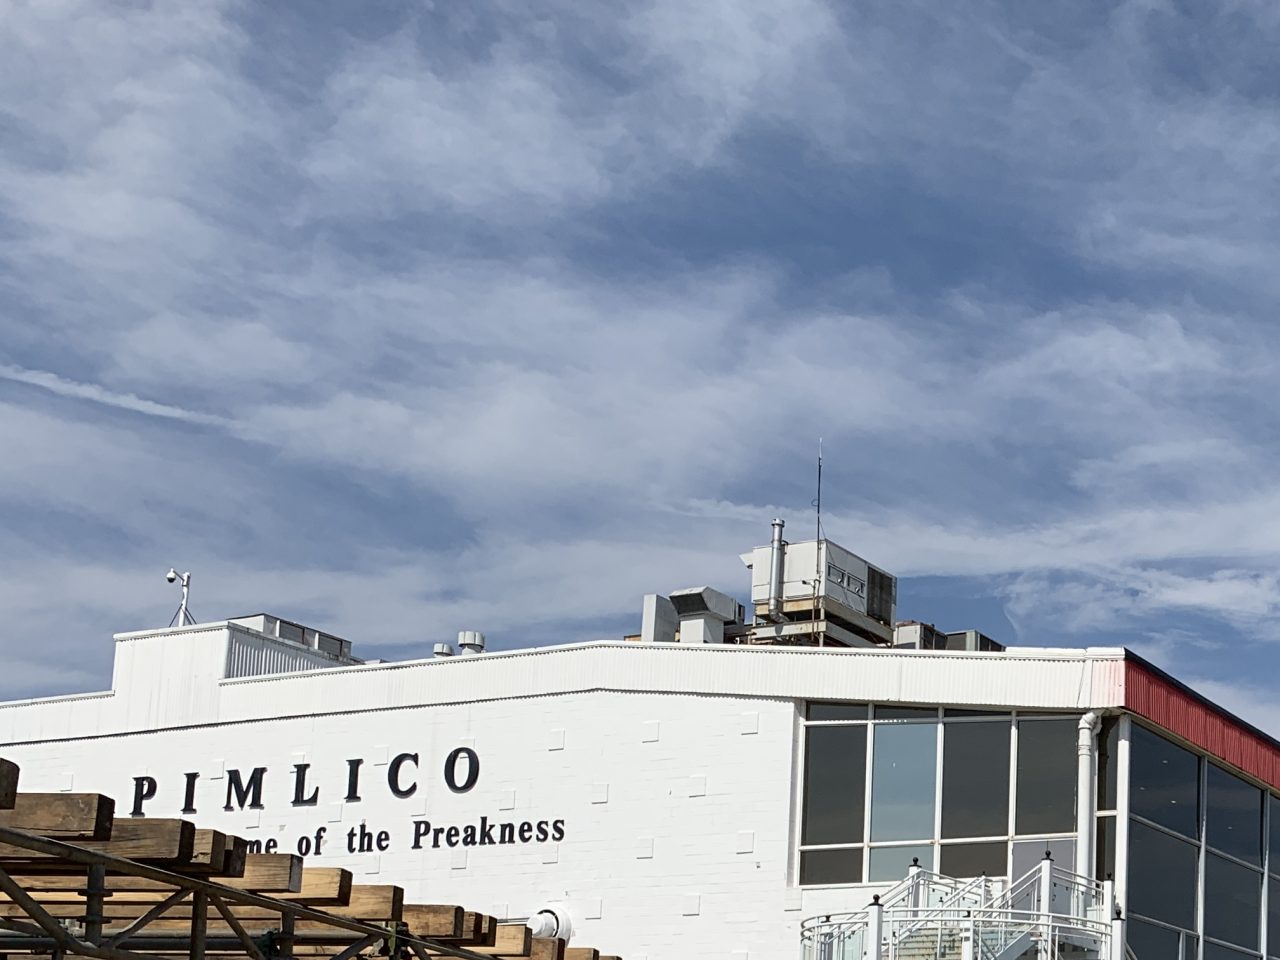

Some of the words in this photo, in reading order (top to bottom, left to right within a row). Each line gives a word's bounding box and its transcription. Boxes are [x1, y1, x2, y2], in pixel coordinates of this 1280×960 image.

[130, 747, 481, 818] PIMLICO
[245, 838, 278, 854] me
[297, 826, 327, 857] of
[346, 823, 390, 854] the
[411, 816, 566, 850] Preakness
